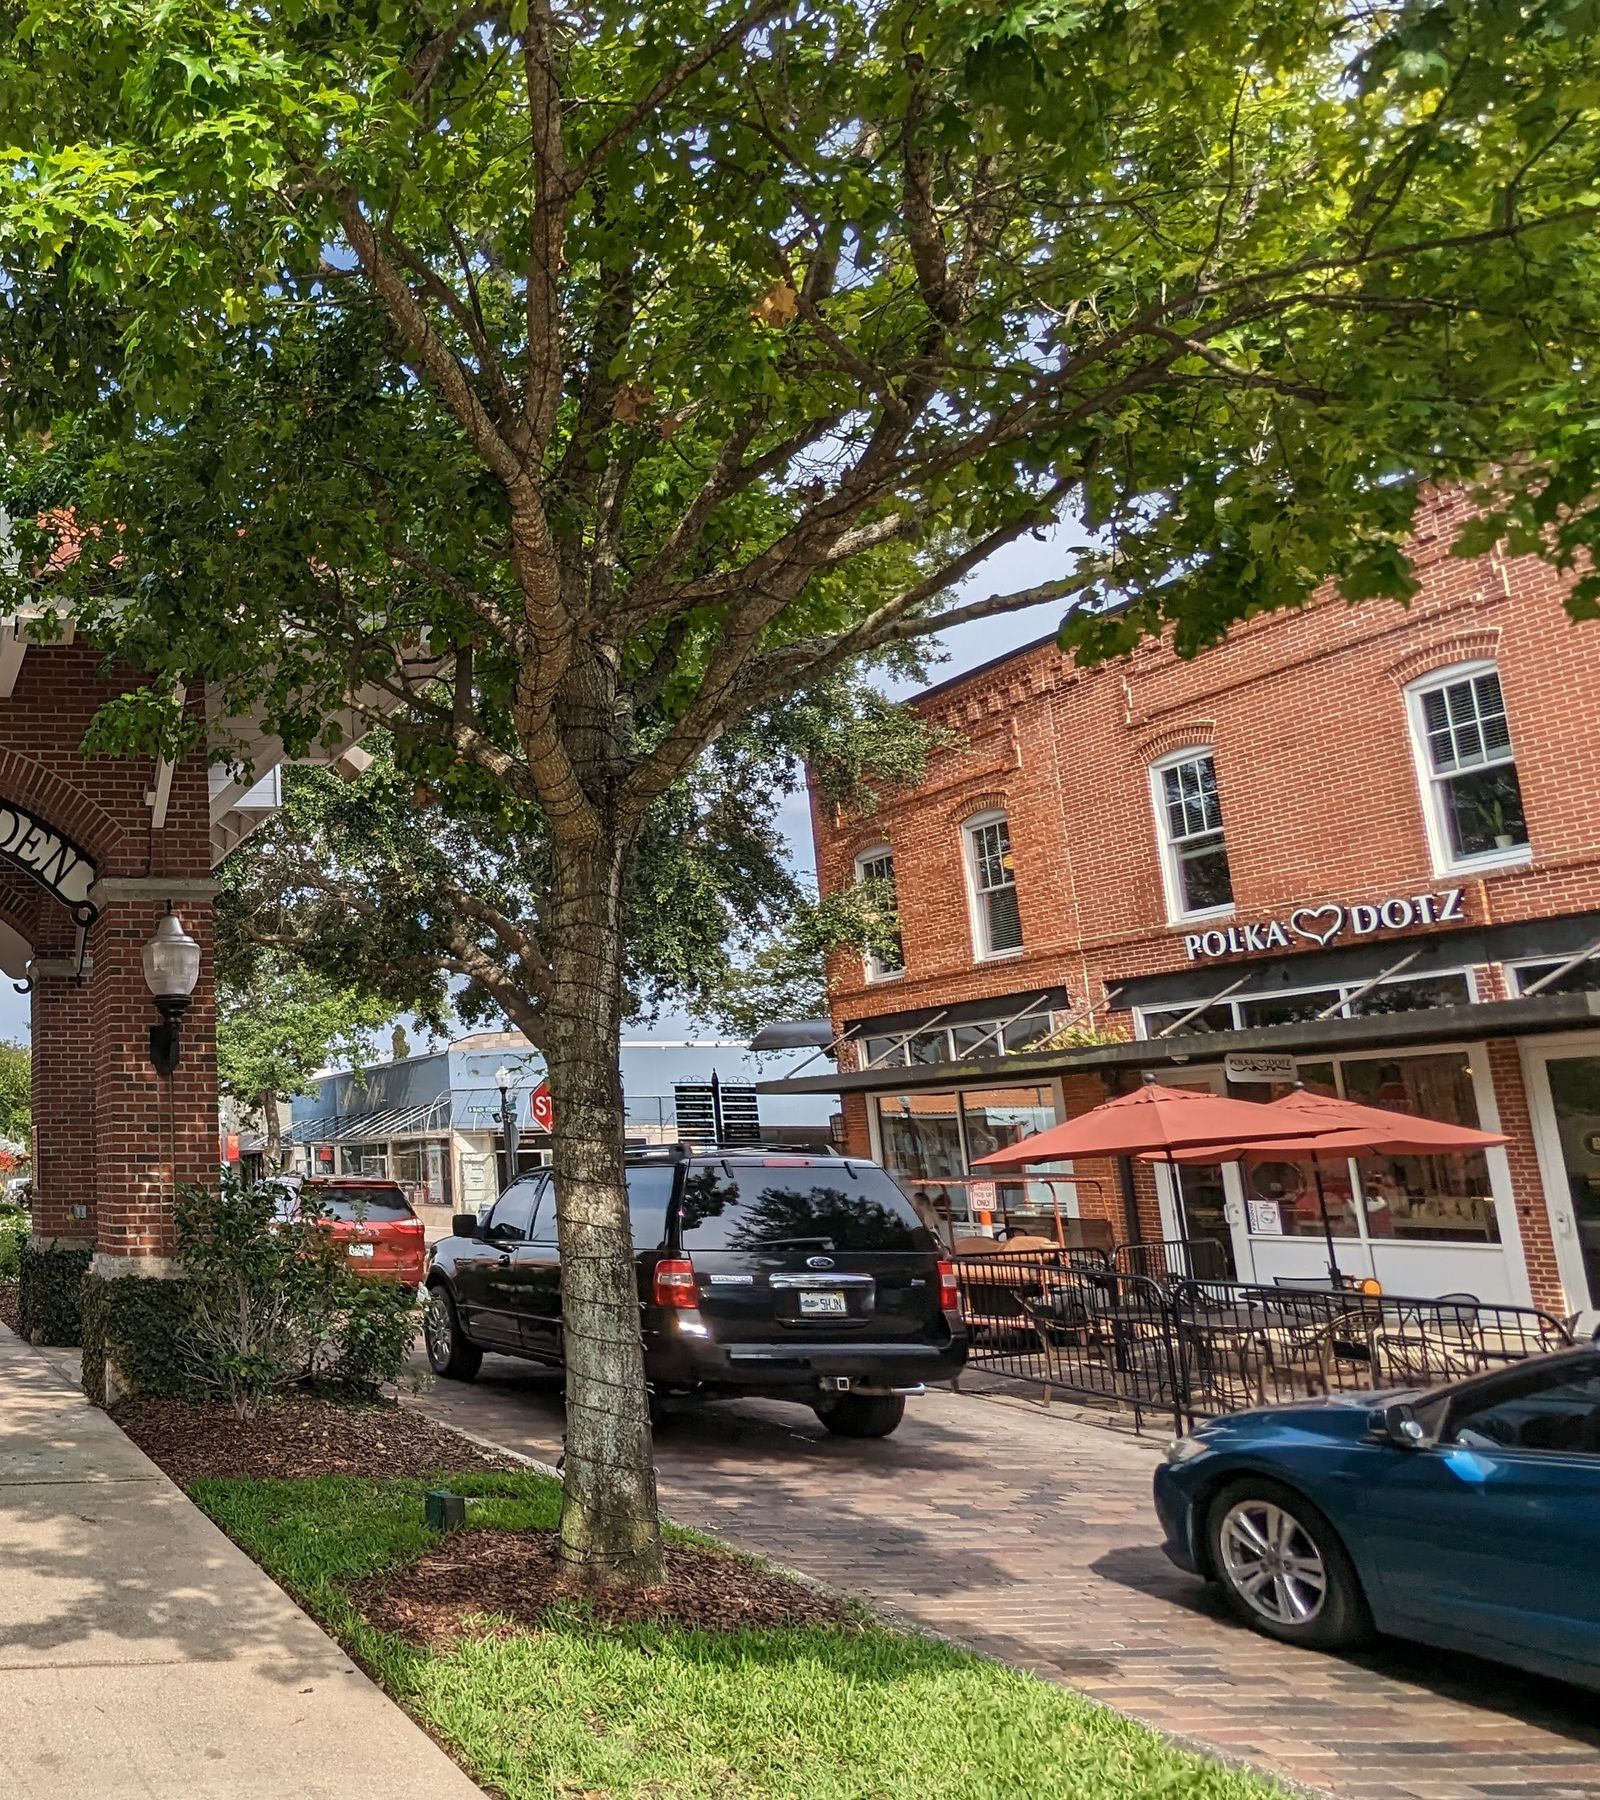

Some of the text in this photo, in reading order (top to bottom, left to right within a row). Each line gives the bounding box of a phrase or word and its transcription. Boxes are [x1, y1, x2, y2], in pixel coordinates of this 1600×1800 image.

[1184, 889, 1465, 960] POLKA DOTZ
[535, 1096, 552, 1116] ST
